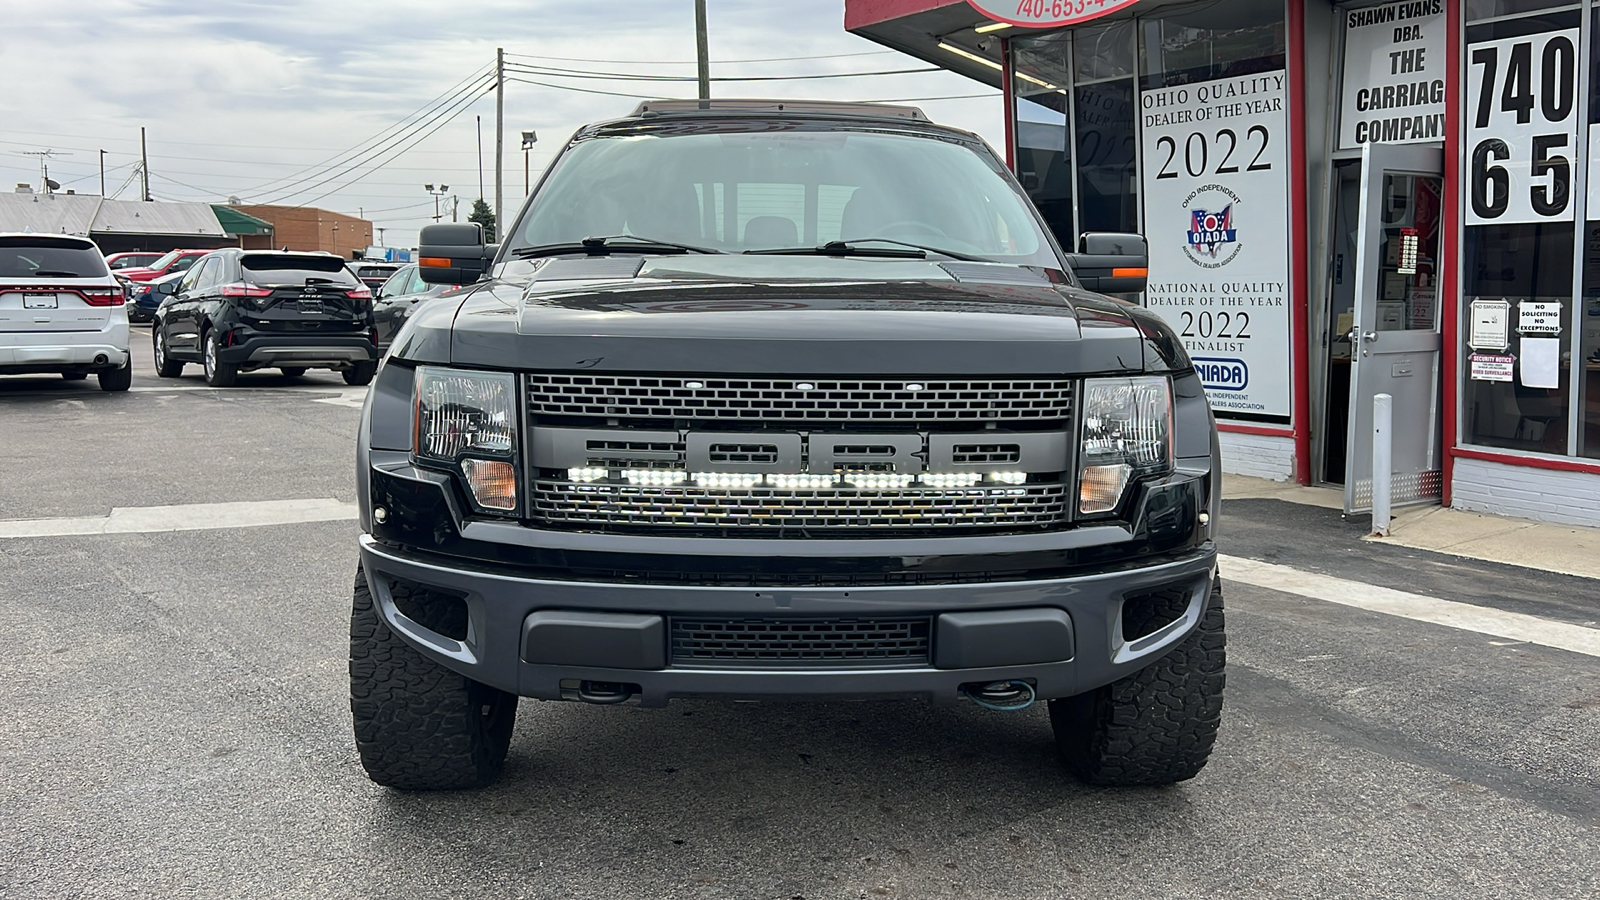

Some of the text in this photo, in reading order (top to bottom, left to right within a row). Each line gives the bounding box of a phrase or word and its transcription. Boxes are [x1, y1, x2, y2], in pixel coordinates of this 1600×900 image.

[1349, 0, 1443, 28] SHAWN EVANS.
[1393, 24, 1423, 43] DBA.
[1389, 47, 1426, 75] THE
[1143, 89, 1188, 109] OHIO
[1197, 75, 1284, 103] QUALITY
[1357, 79, 1446, 111] CARRIAG
[1471, 36, 1575, 129] 740
[1145, 109, 1193, 127] DEALER
[1196, 107, 1212, 121] OF
[1215, 103, 1242, 118] THE
[1245, 98, 1282, 115] YEAR
[1156, 124, 1272, 180] 2022
[1182, 184, 1241, 208] OHIO INDEPENDENT
[1193, 230, 1228, 243] OIADA
[1149, 282, 1284, 294] NATIONAL QUALITY
[1150, 297, 1283, 306] DEALER OF THE YEAR
[1181, 311, 1251, 338] 2022
[1185, 341, 1244, 352] FINALIST
[1228, 402, 1265, 410] ASSOCIATION
